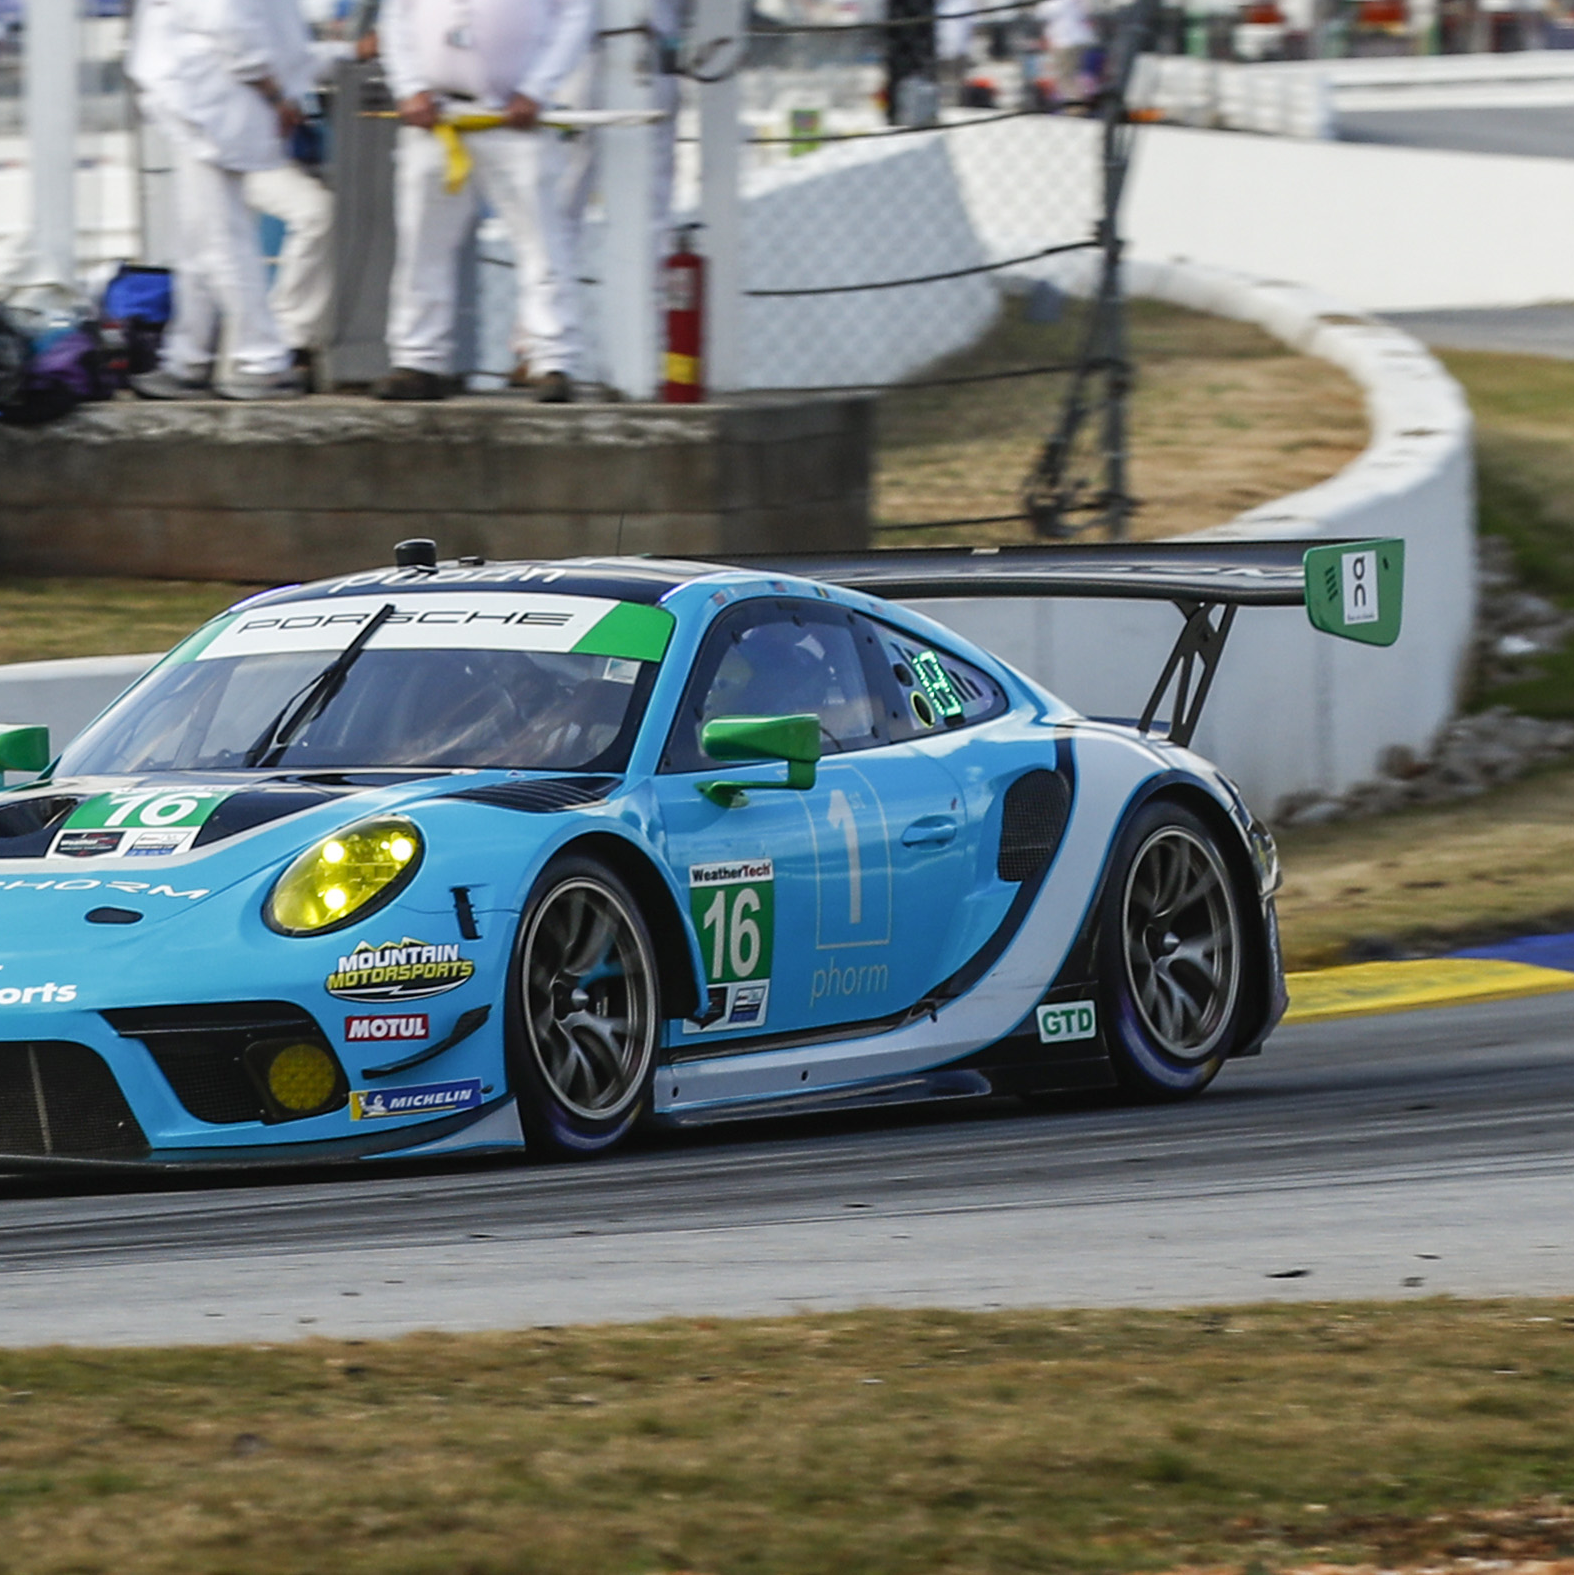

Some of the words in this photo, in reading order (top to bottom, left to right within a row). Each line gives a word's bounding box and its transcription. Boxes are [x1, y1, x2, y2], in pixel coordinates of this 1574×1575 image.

[237, 609, 576, 634] PORSCHE
[103, 791, 213, 827] 16
[692, 862, 771, 882] WeatherTech
[703, 887, 761, 979] 16
[337, 943, 459, 974] MOUNTAIN
[327, 960, 474, 991] MOTORSPORTS
[809, 956, 889, 1008] phorm
[347, 1017, 427, 1039] MOTUL
[1041, 1007, 1094, 1036] GTD
[389, 1088, 473, 1110] MICHELIN
